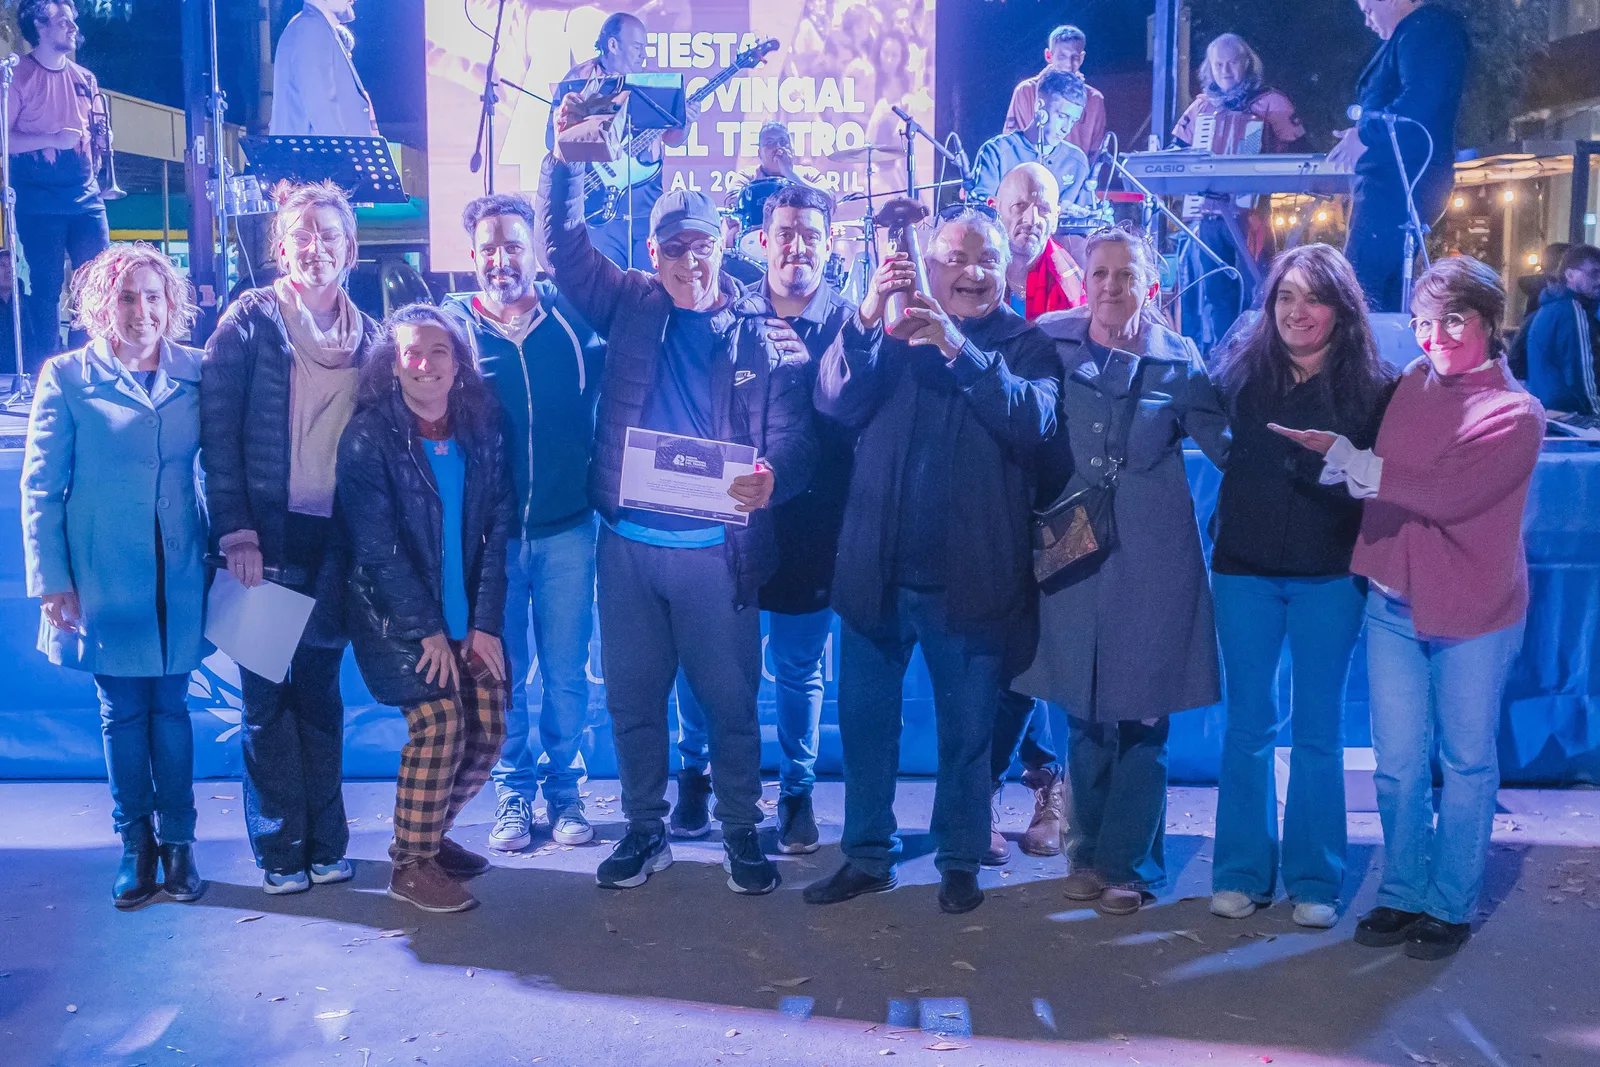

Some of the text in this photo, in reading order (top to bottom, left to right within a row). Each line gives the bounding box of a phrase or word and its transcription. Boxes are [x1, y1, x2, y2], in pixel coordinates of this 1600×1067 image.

[685, 76, 865, 113] OVINCIAL
[717, 121, 865, 156] TETRO
[670, 170, 702, 192] AL
[826, 170, 865, 192] RIL
[1144, 164, 1185, 173] CASIO
